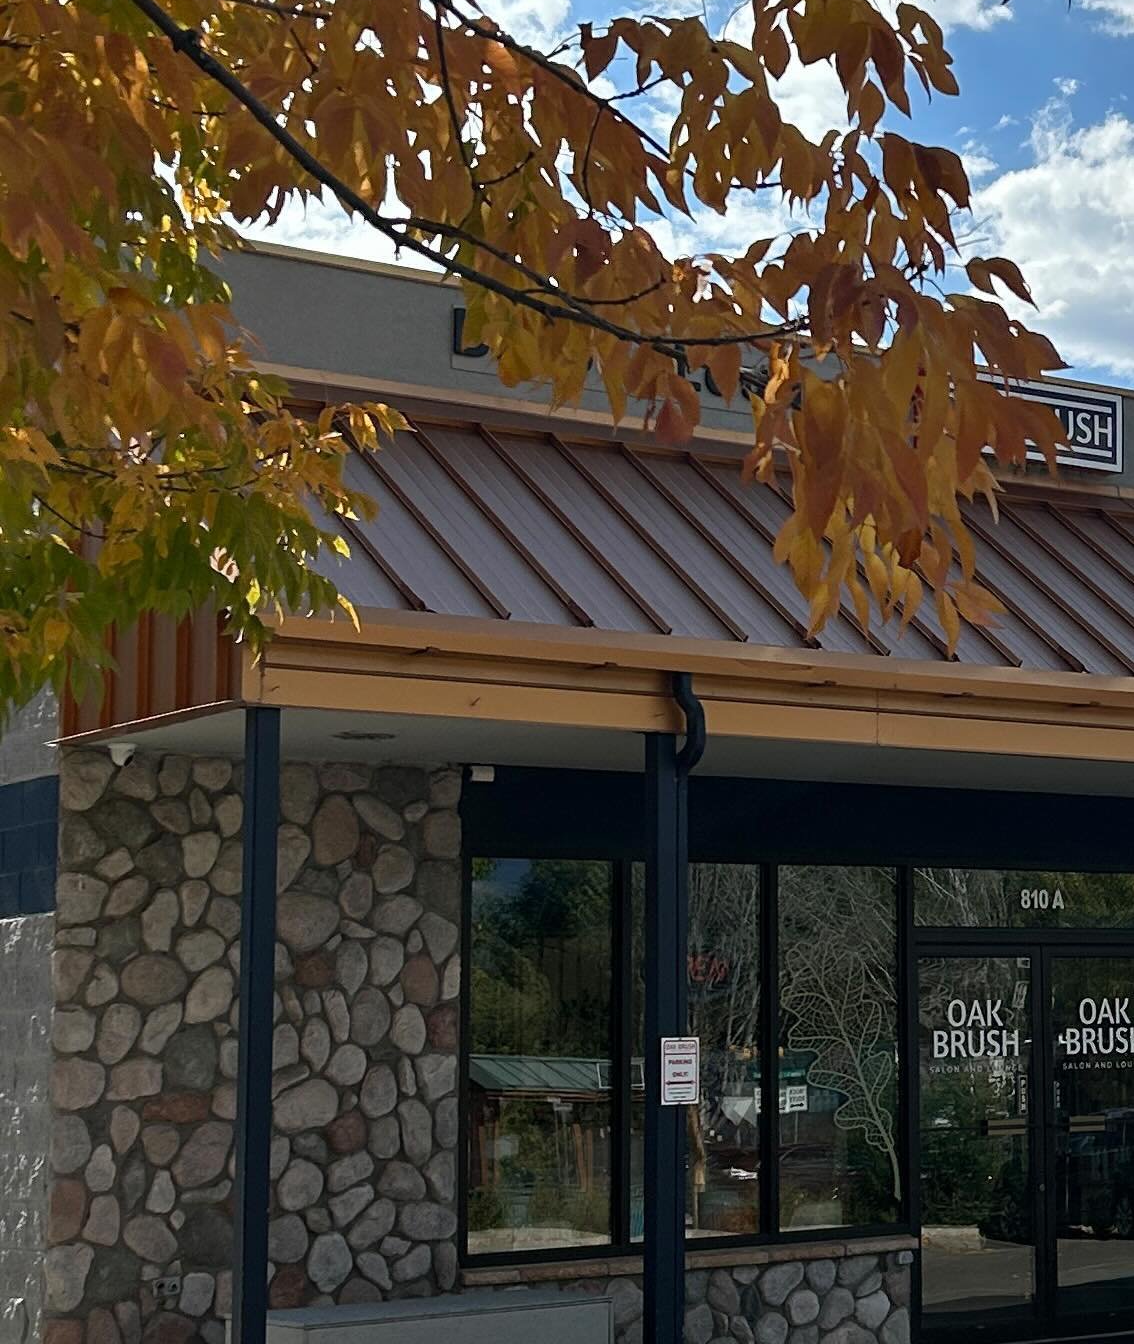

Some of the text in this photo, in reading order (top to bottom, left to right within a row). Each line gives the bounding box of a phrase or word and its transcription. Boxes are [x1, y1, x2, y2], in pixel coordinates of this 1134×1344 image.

[1020, 889, 1065, 909] 810 A
[947, 999, 1003, 1027] OAK
[1079, 997, 1131, 1025] OAK
[933, 1029, 1019, 1058] BRUSH
[1062, 1061, 1091, 1070] SALON
[1094, 1061, 1113, 1069] AND
